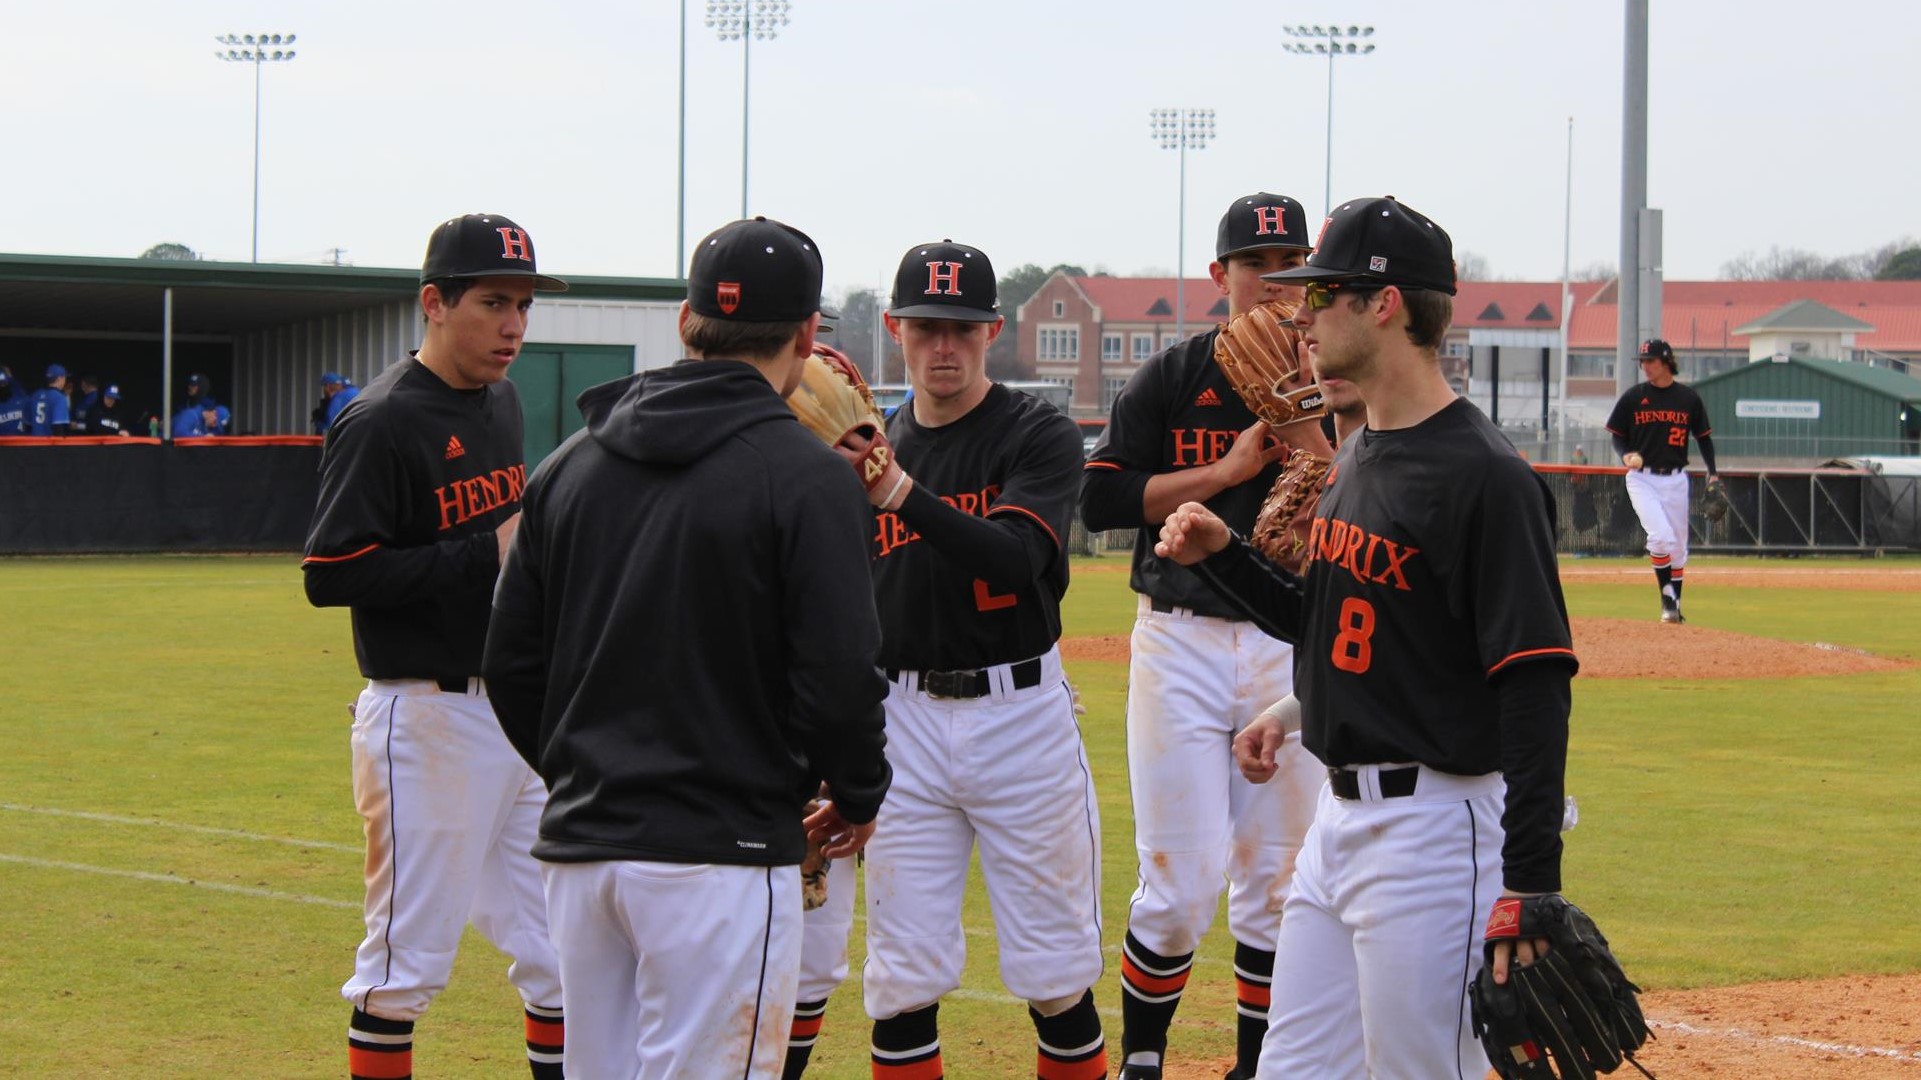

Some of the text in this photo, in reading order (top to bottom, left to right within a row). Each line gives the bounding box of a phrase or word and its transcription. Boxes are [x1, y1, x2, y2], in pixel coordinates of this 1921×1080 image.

[1254, 206, 1288, 235] H
[496, 227, 531, 262] H
[924, 261, 963, 295] H
[36, 402, 46, 424] 5
[1634, 410, 1688, 425] HENDRIX
[864, 446, 888, 482] 44
[1331, 597, 1376, 674] 8
